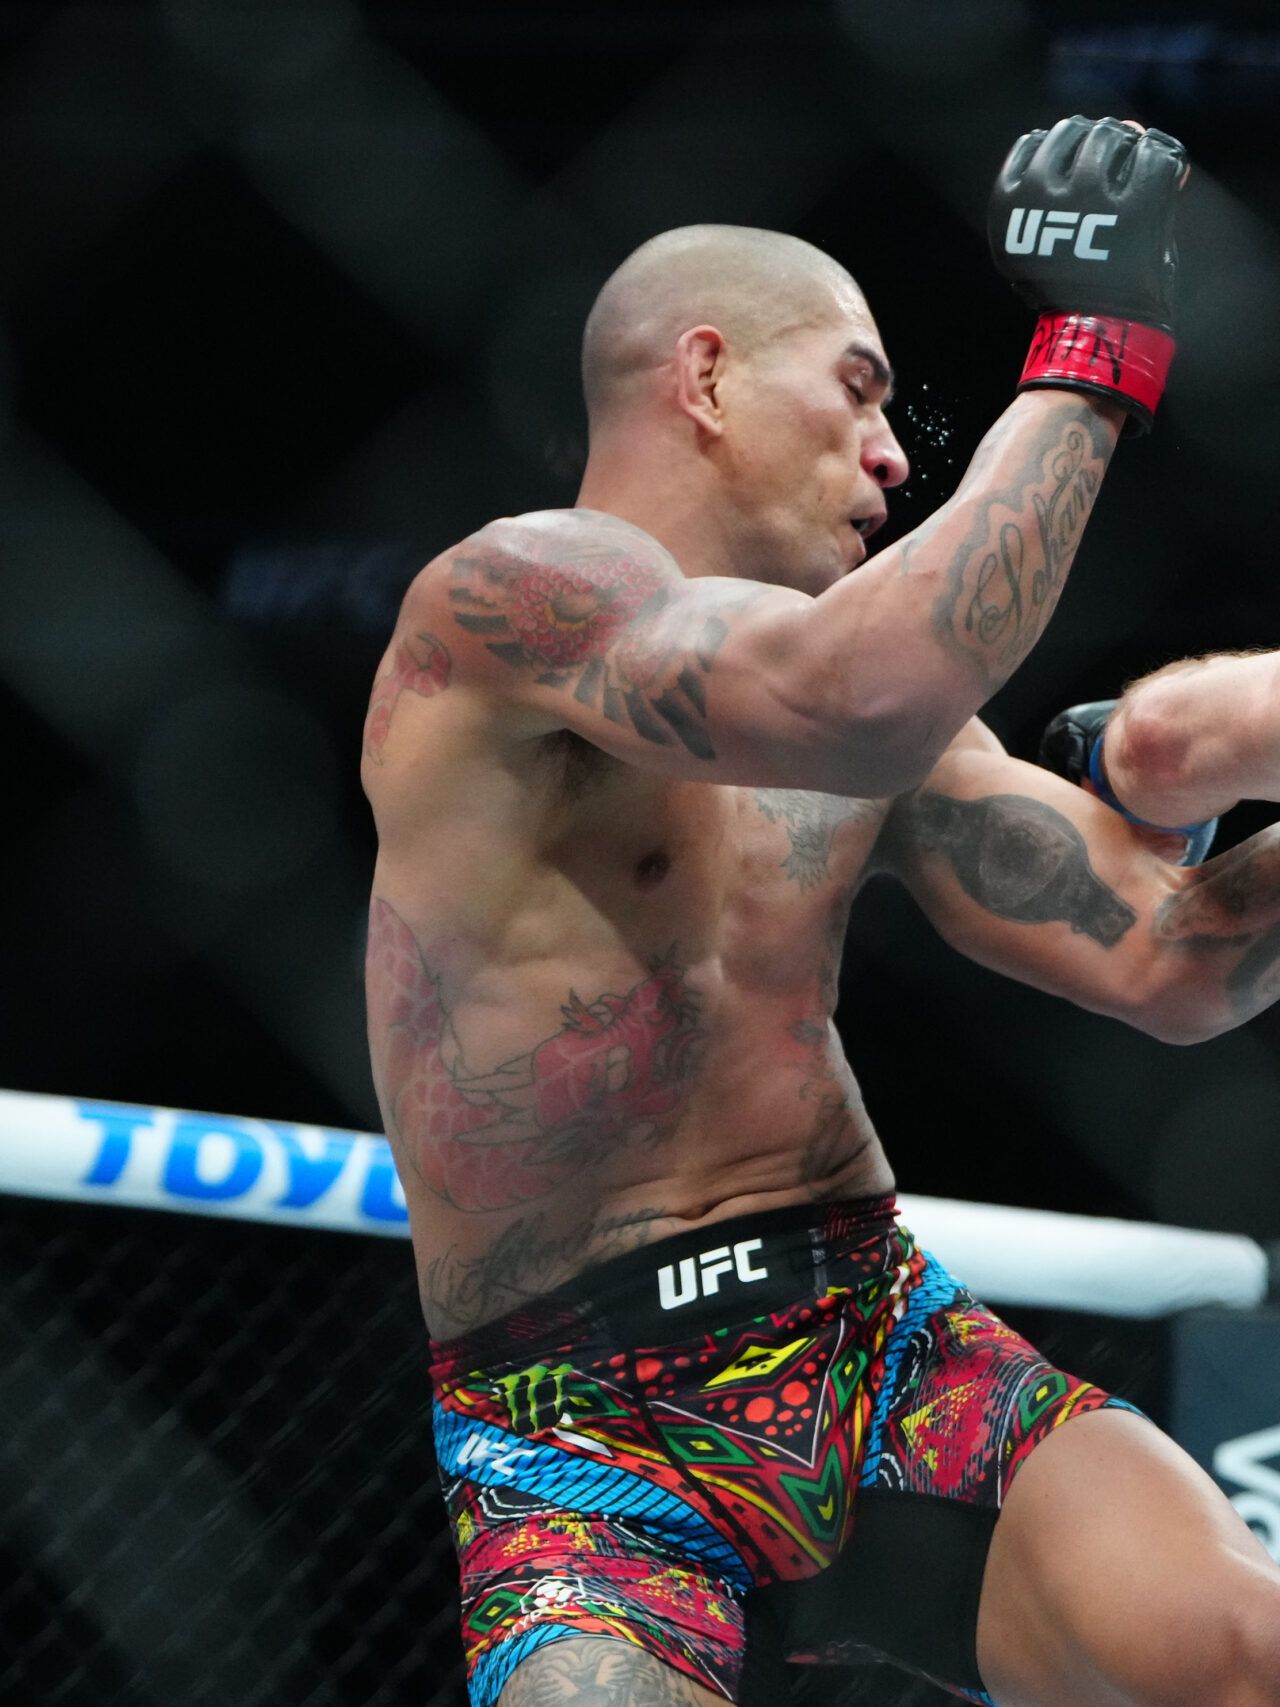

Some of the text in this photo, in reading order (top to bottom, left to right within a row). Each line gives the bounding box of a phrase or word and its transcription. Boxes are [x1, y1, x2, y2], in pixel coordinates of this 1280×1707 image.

[1005, 207, 1118, 261] UFC
[657, 1238, 768, 1310] UFC
[457, 1432, 537, 1477] UFC
